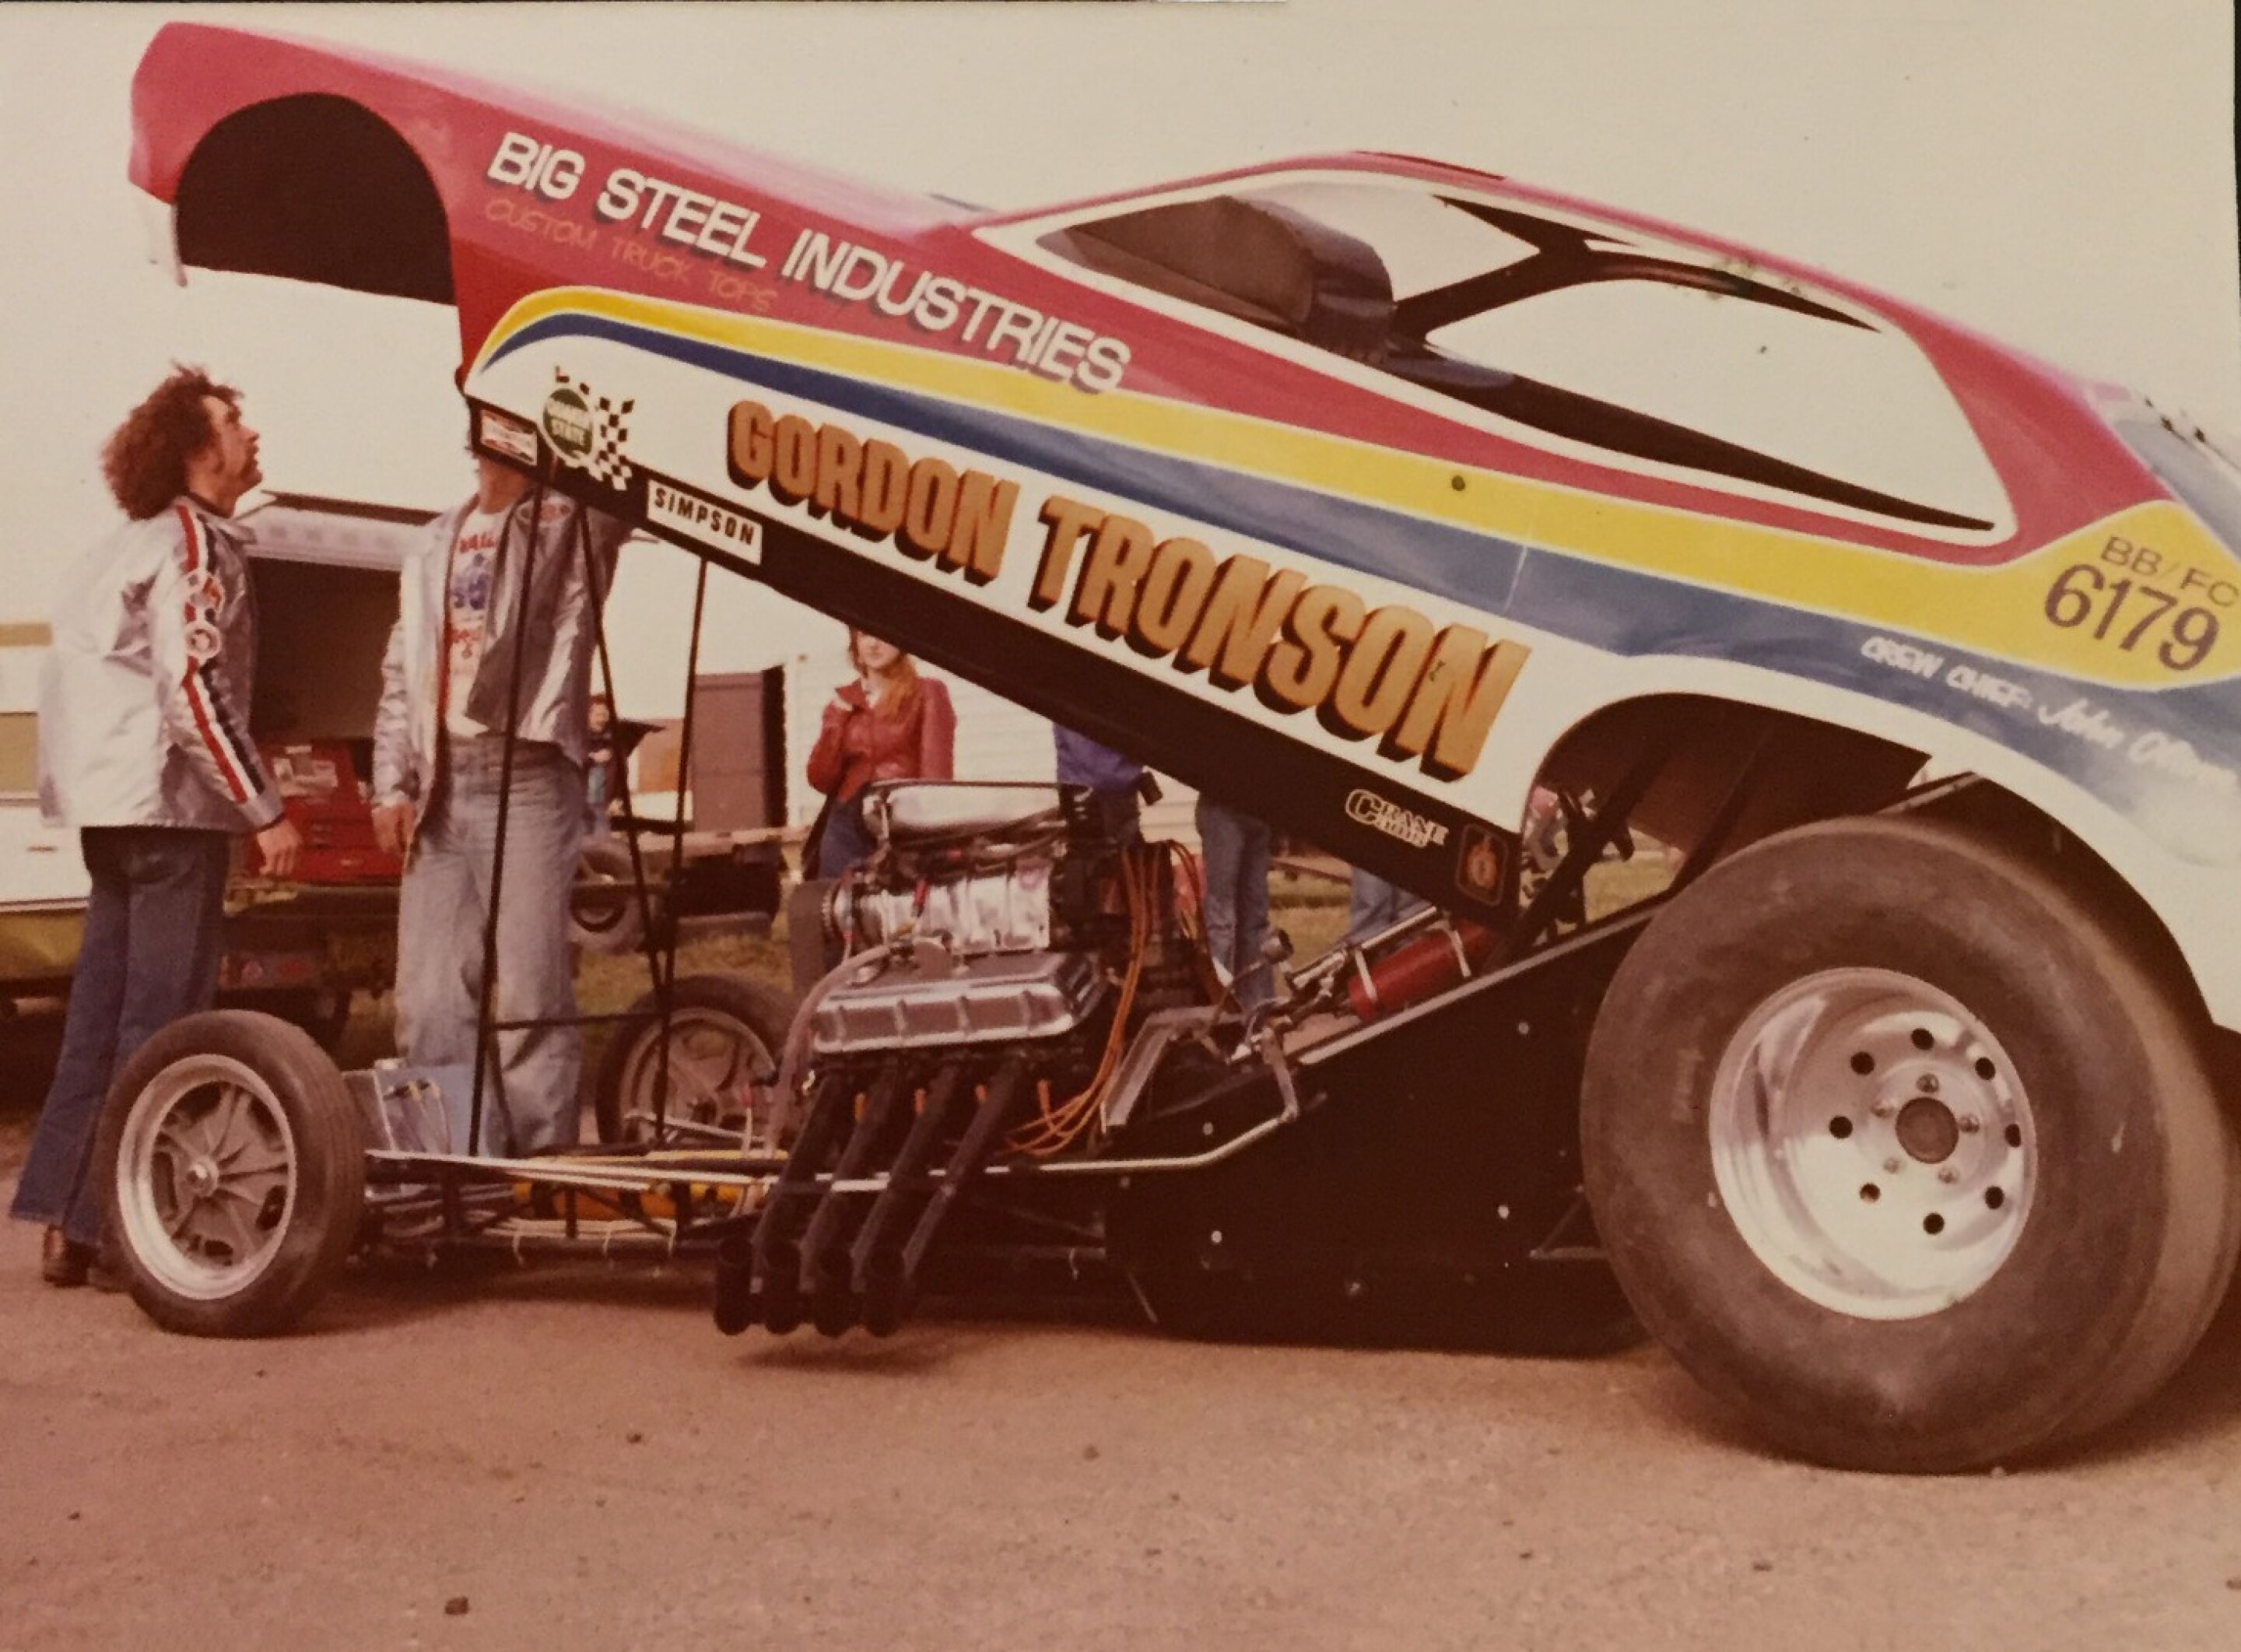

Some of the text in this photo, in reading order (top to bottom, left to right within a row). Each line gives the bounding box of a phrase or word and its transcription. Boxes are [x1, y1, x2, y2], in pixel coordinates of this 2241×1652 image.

[485, 199, 777, 311] CUSTOM TRUCK TOPS
[487, 132, 1131, 391] BIG STEEL INDUSTRIES
[654, 488, 756, 545] SIMPSON
[727, 398, 1532, 782] GORDON TRONSON
[2044, 563, 2220, 672] 6179
